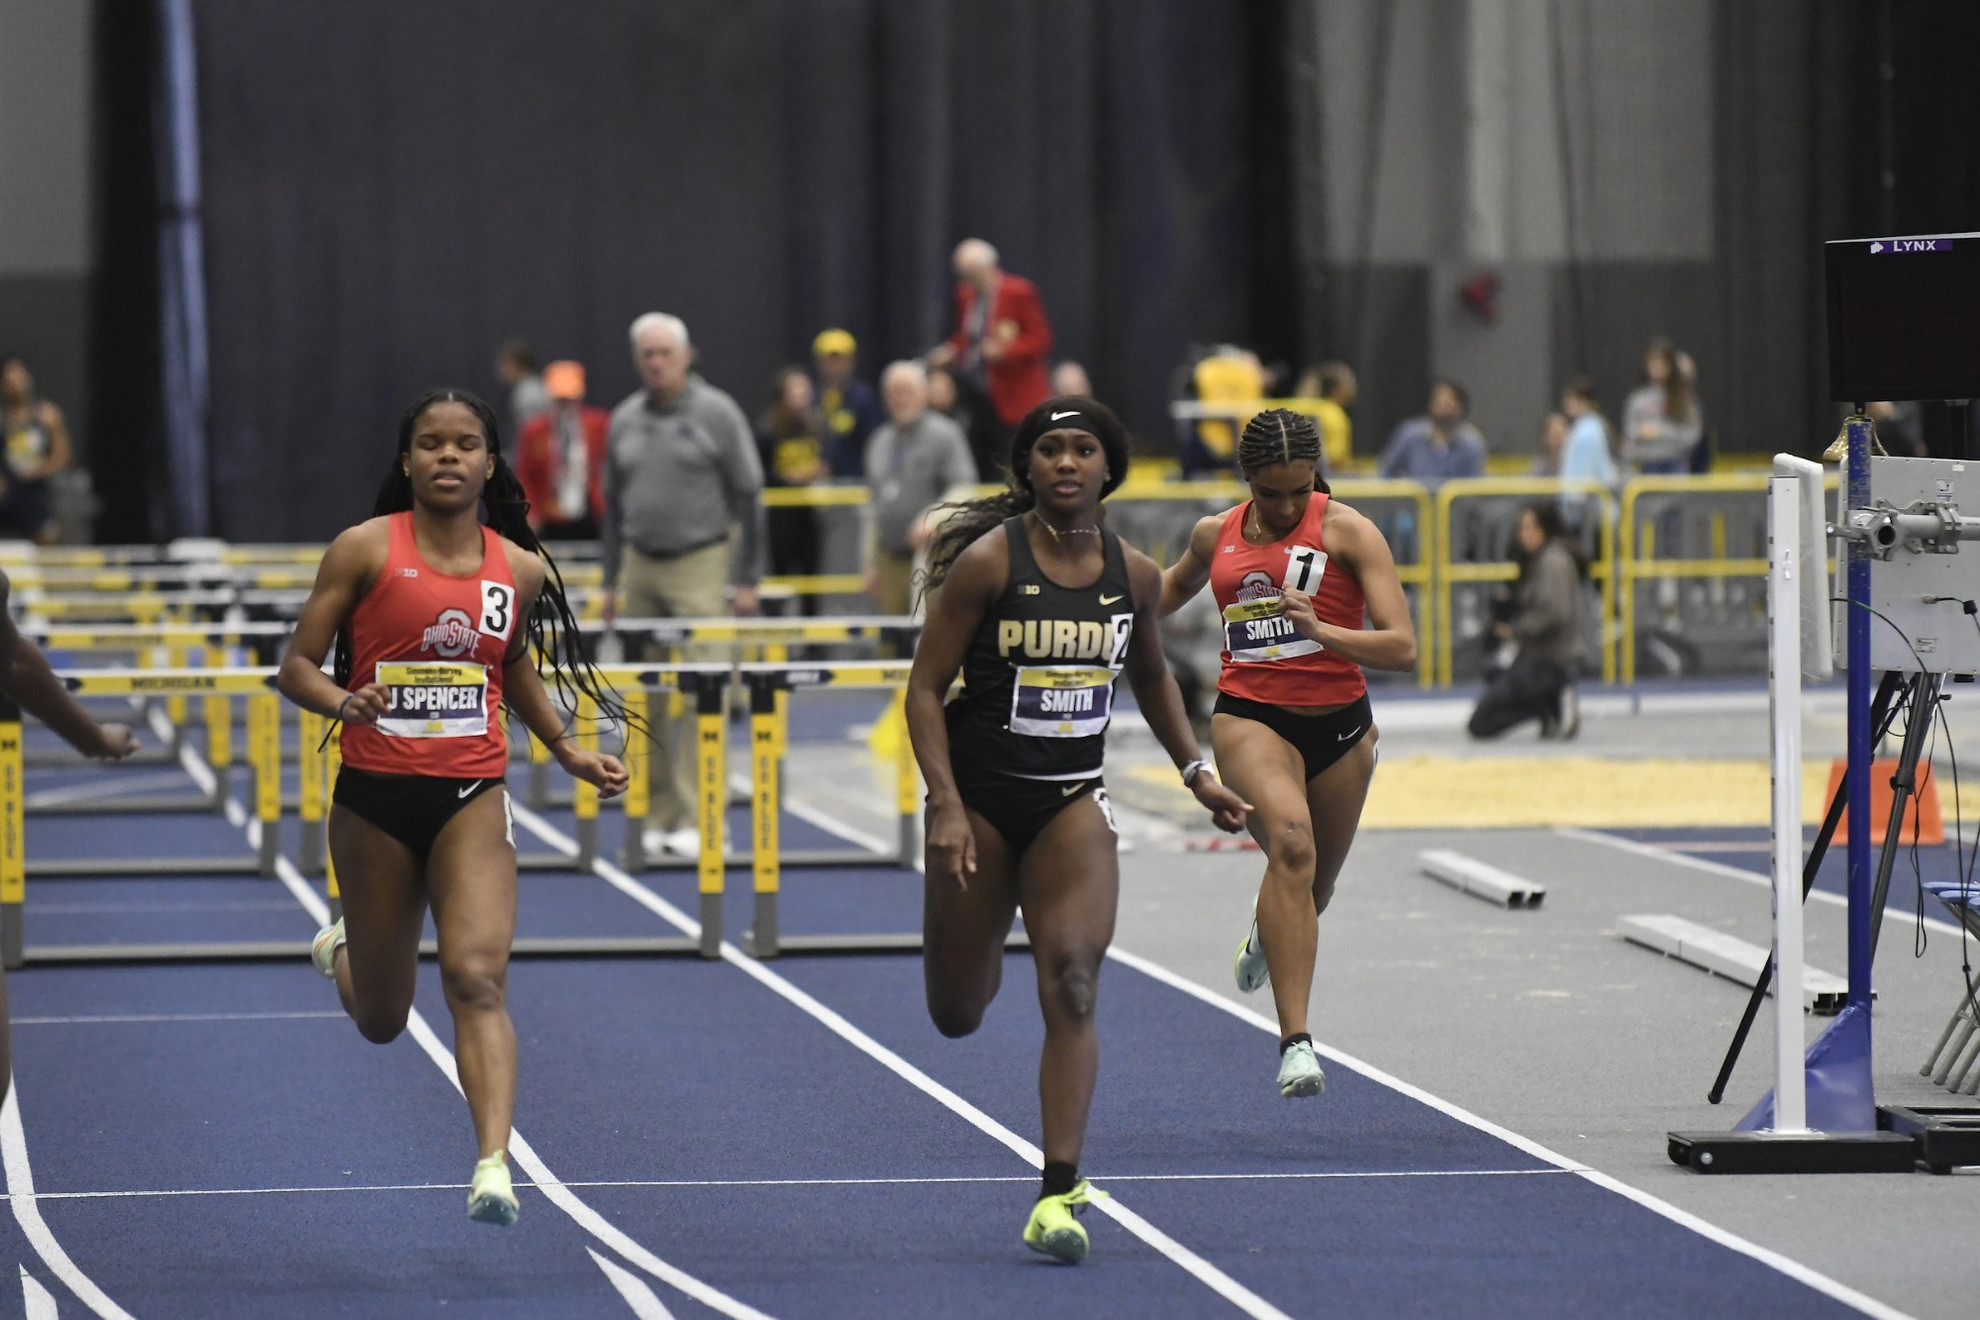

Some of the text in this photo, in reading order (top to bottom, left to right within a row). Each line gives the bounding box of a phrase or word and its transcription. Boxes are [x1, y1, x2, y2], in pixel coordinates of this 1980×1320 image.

[1893, 240, 1936, 252] LYNX
[1296, 552, 1315, 591] 1
[485, 586, 508, 633] 3
[1245, 616, 1295, 640] SMITH
[387, 686, 479, 711] J SPENCER
[1040, 689, 1094, 712] SMITH
